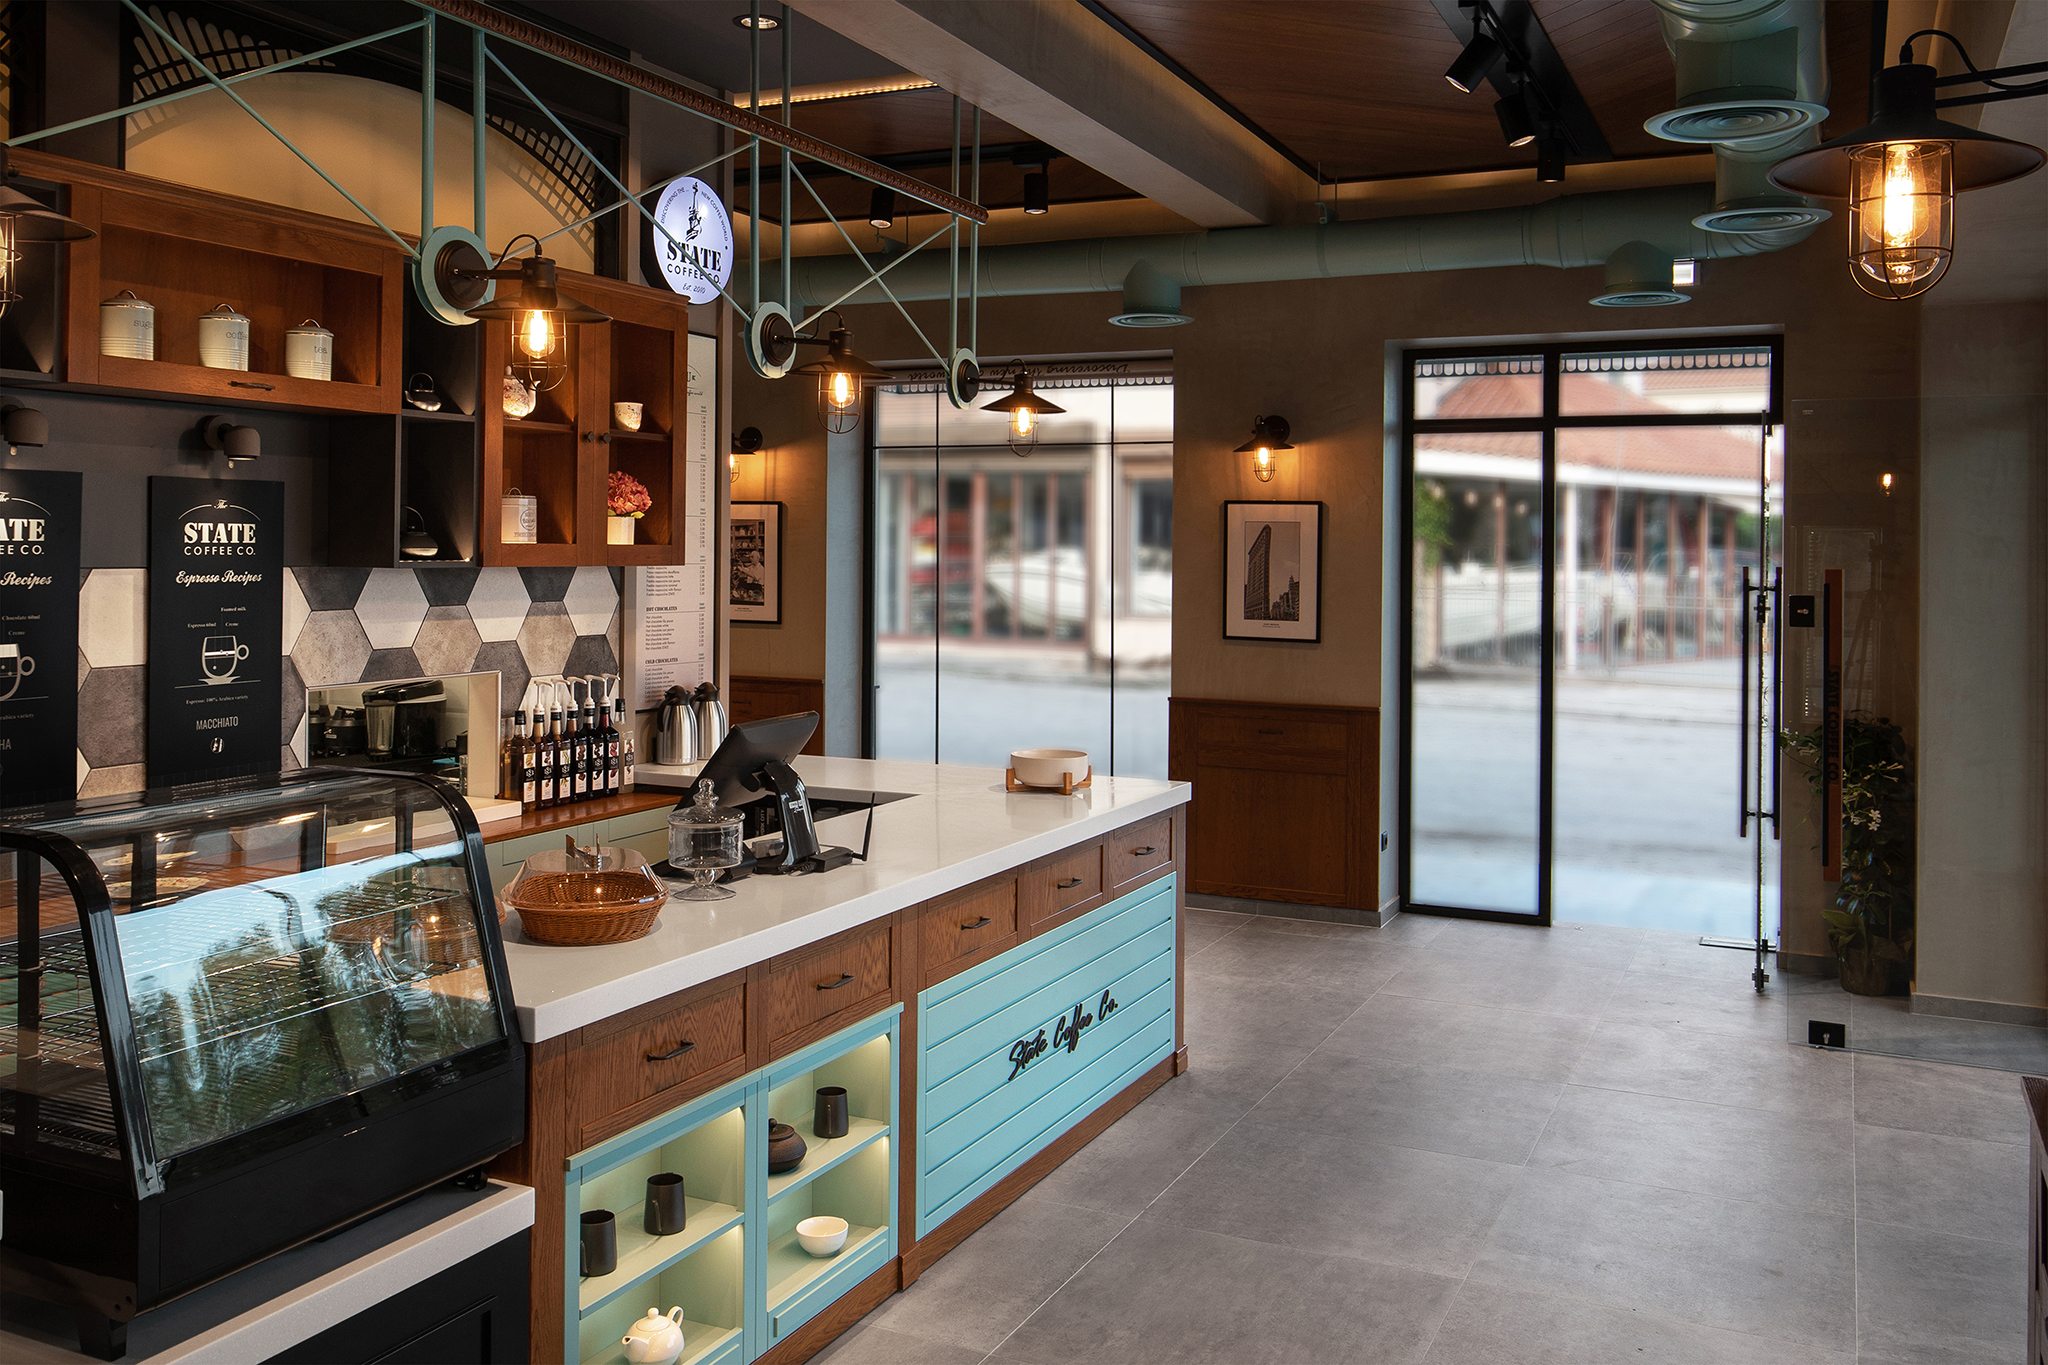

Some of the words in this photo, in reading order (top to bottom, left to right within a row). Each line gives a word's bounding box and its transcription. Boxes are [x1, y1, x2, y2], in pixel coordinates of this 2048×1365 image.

[666, 240, 722, 272] STATE
[666, 263, 705, 281] COFFEE
[133, 319, 153, 330] sug
[225, 330, 248, 341] coffe
[314, 345, 328, 354] tea
[0, 518, 45, 541] ATE
[184, 522, 256, 544] STATE
[20, 545, 45, 555] CO.
[184, 546, 233, 556] COFFEE
[236, 546, 256, 556] CO.
[0, 570, 53, 590] Recipes
[175, 570, 220, 588] Espresso
[220, 569, 263, 587] Recipes
[1827, 670, 1840, 708] STATE
[195, 715, 239, 731] MACCHIATO
[1827, 711, 1840, 758] COFFEE
[1008, 1029, 1049, 1082] State
[1053, 1002, 1094, 1054] Coffee
[1098, 989, 1119, 1022] Co.
